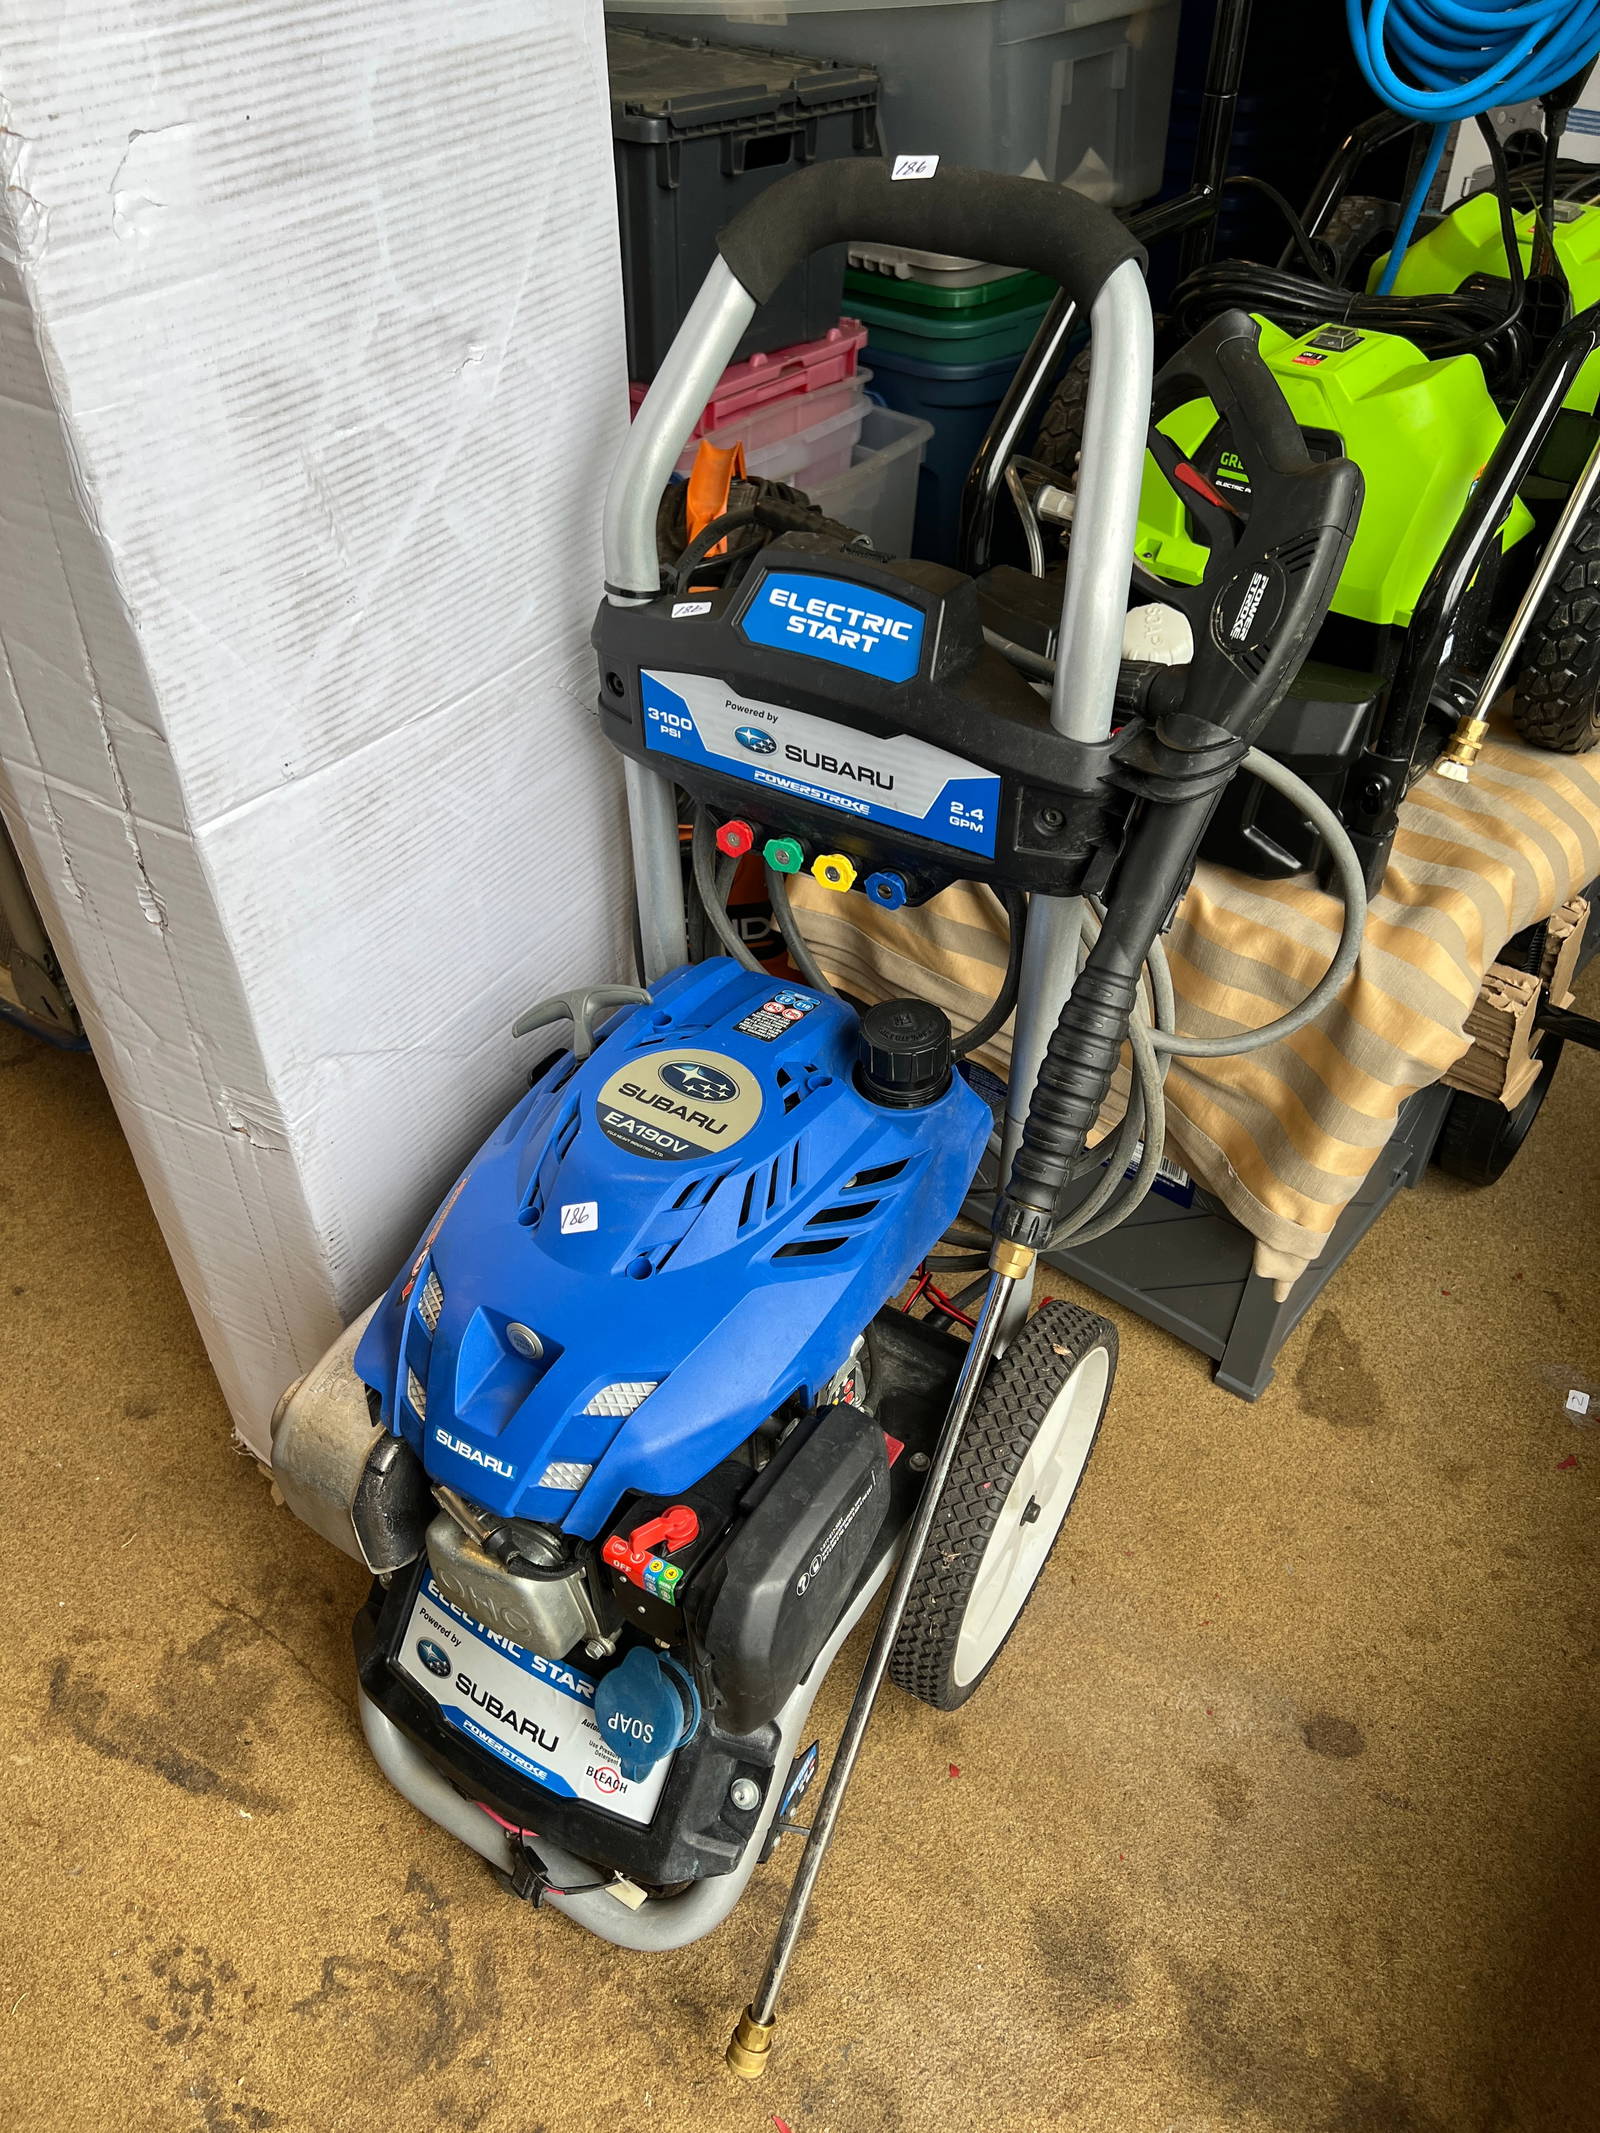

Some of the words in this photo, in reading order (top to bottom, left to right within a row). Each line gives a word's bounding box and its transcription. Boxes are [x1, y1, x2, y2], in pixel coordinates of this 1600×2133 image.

[895, 160, 927, 176] 186
[768, 587, 913, 642] ELECTRIC
[1230, 572, 1263, 640] STROKE
[1240, 575, 1270, 641] POWER
[786, 614, 880, 653] START
[647, 707, 694, 731] 3100
[660, 724, 682, 739] PSI
[725, 699, 765, 719] Powered
[766, 711, 779, 724] by
[785, 744, 895, 791] SUBARU
[753, 770, 871, 816] POWERSTROKE
[950, 801, 985, 821] 2.4
[949, 815, 984, 834] GPM
[618, 1082, 728, 1135] SUBARU
[603, 1111, 689, 1153] EA190V
[562, 1206, 590, 1229] 186
[436, 1428, 513, 1478] SUBARU
[613, 1559, 632, 1573] OFF
[419, 1607, 451, 1638] Powered
[450, 1633, 462, 1647] by
[531, 1655, 595, 1700] STAR
[455, 1672, 559, 1753] SUBARU
[607, 1711, 654, 1744] SOAP
[462, 1719, 548, 1782] POWERSTROKE
[585, 1765, 628, 1794] BLEACH
